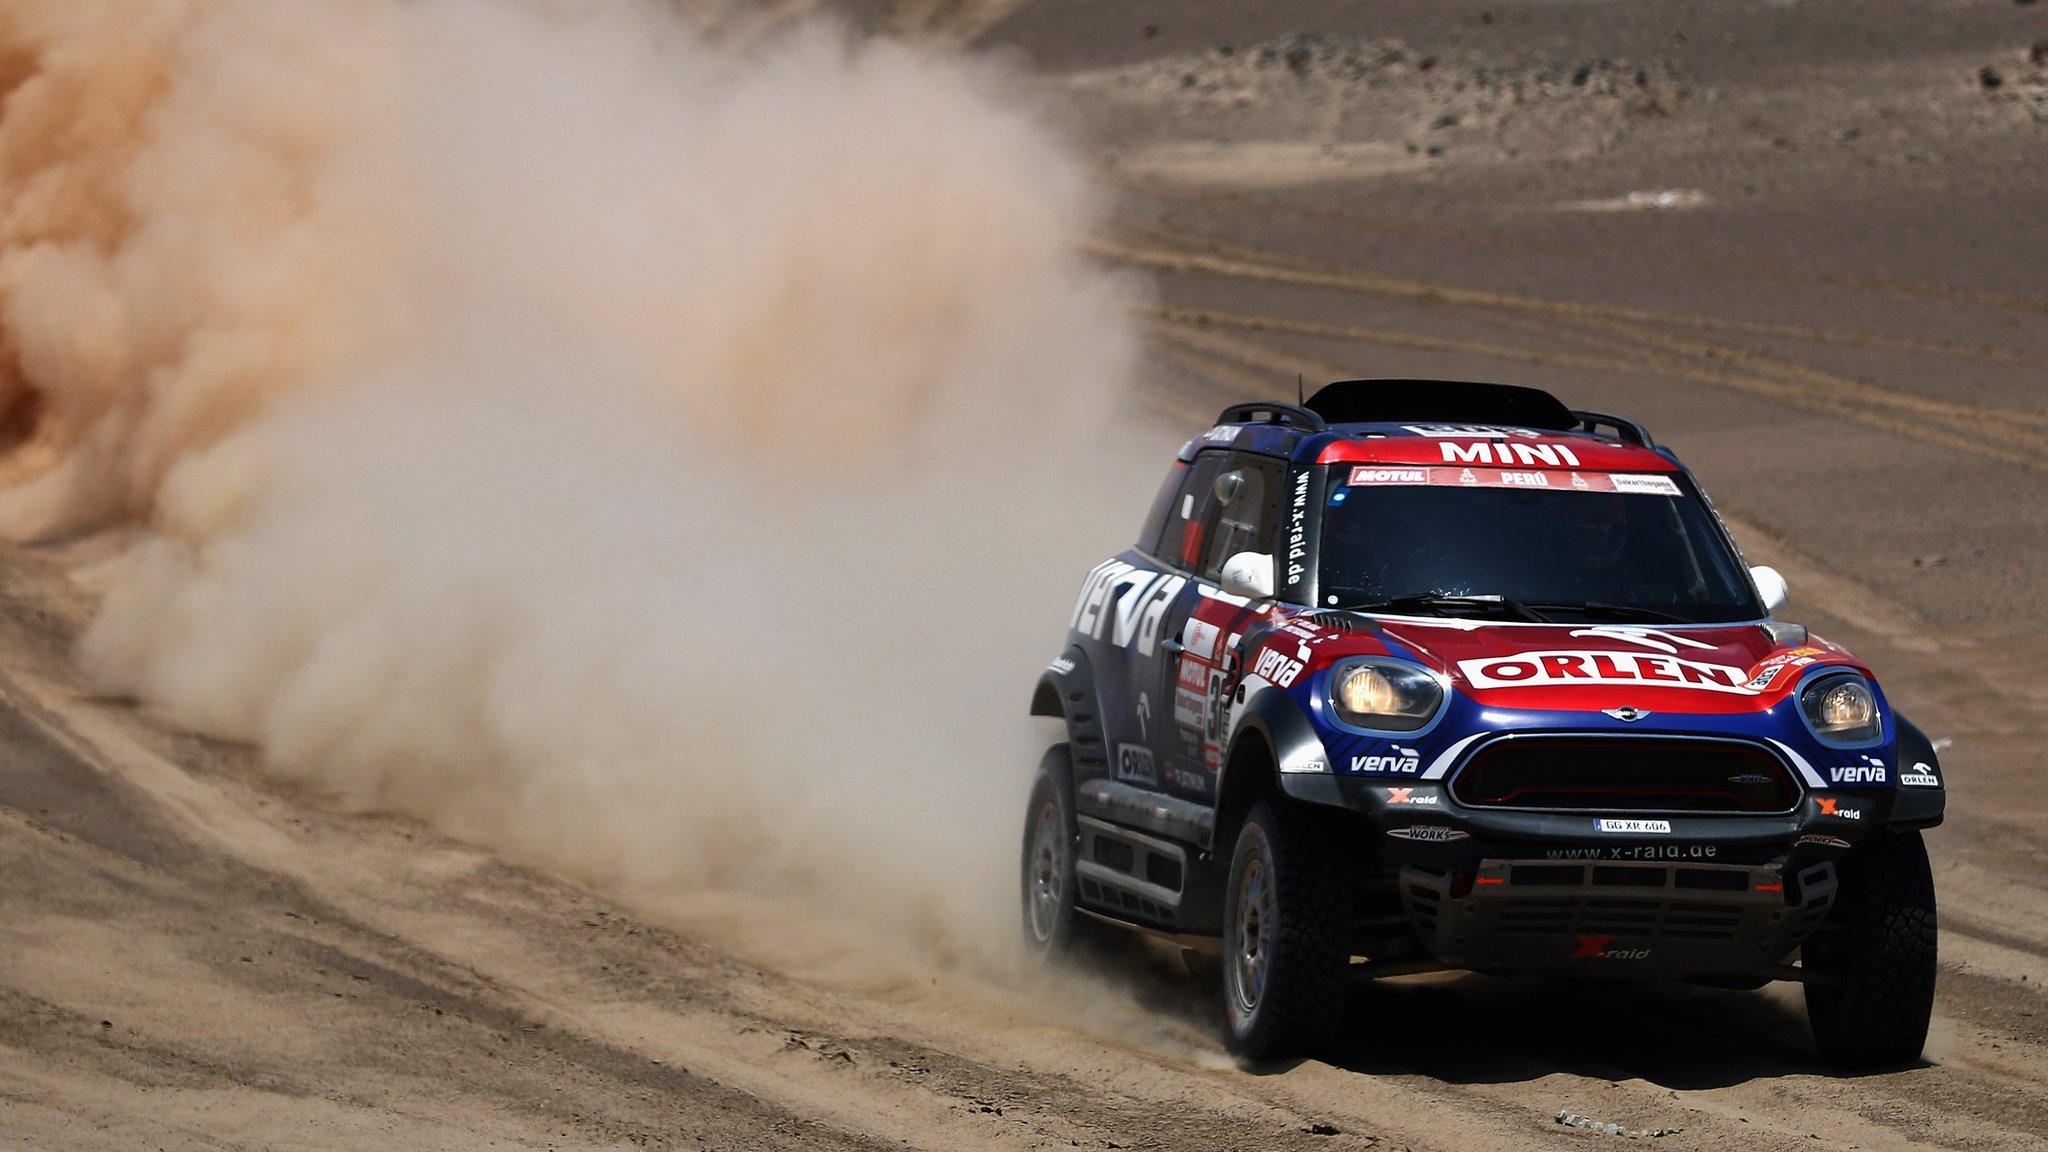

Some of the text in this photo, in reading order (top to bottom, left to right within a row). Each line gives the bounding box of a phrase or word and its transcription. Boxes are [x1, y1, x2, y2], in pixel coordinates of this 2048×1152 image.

[1439, 442, 1580, 467] MINI
[1355, 470, 1425, 482] MOTUL
[1501, 471, 1549, 485] PERÚ
[1287, 471, 1310, 585] www.x-raid.de
[1070, 557, 1187, 658] verva
[1253, 646, 1304, 689] verva
[1481, 655, 1737, 688] ORLEN
[1350, 755, 1420, 773] verva
[1829, 765, 1886, 783] verva
[1903, 776, 1936, 784] ORLEN
[1386, 787, 1439, 805] X-raid
[1815, 796, 1861, 820] X-raid
[1409, 829, 1451, 840] WORKS
[1626, 821, 1641, 831] XR
[1644, 821, 1667, 831] 606
[1546, 844, 1717, 860] www.x-raid.de
[1570, 933, 1652, 960] X-raid
